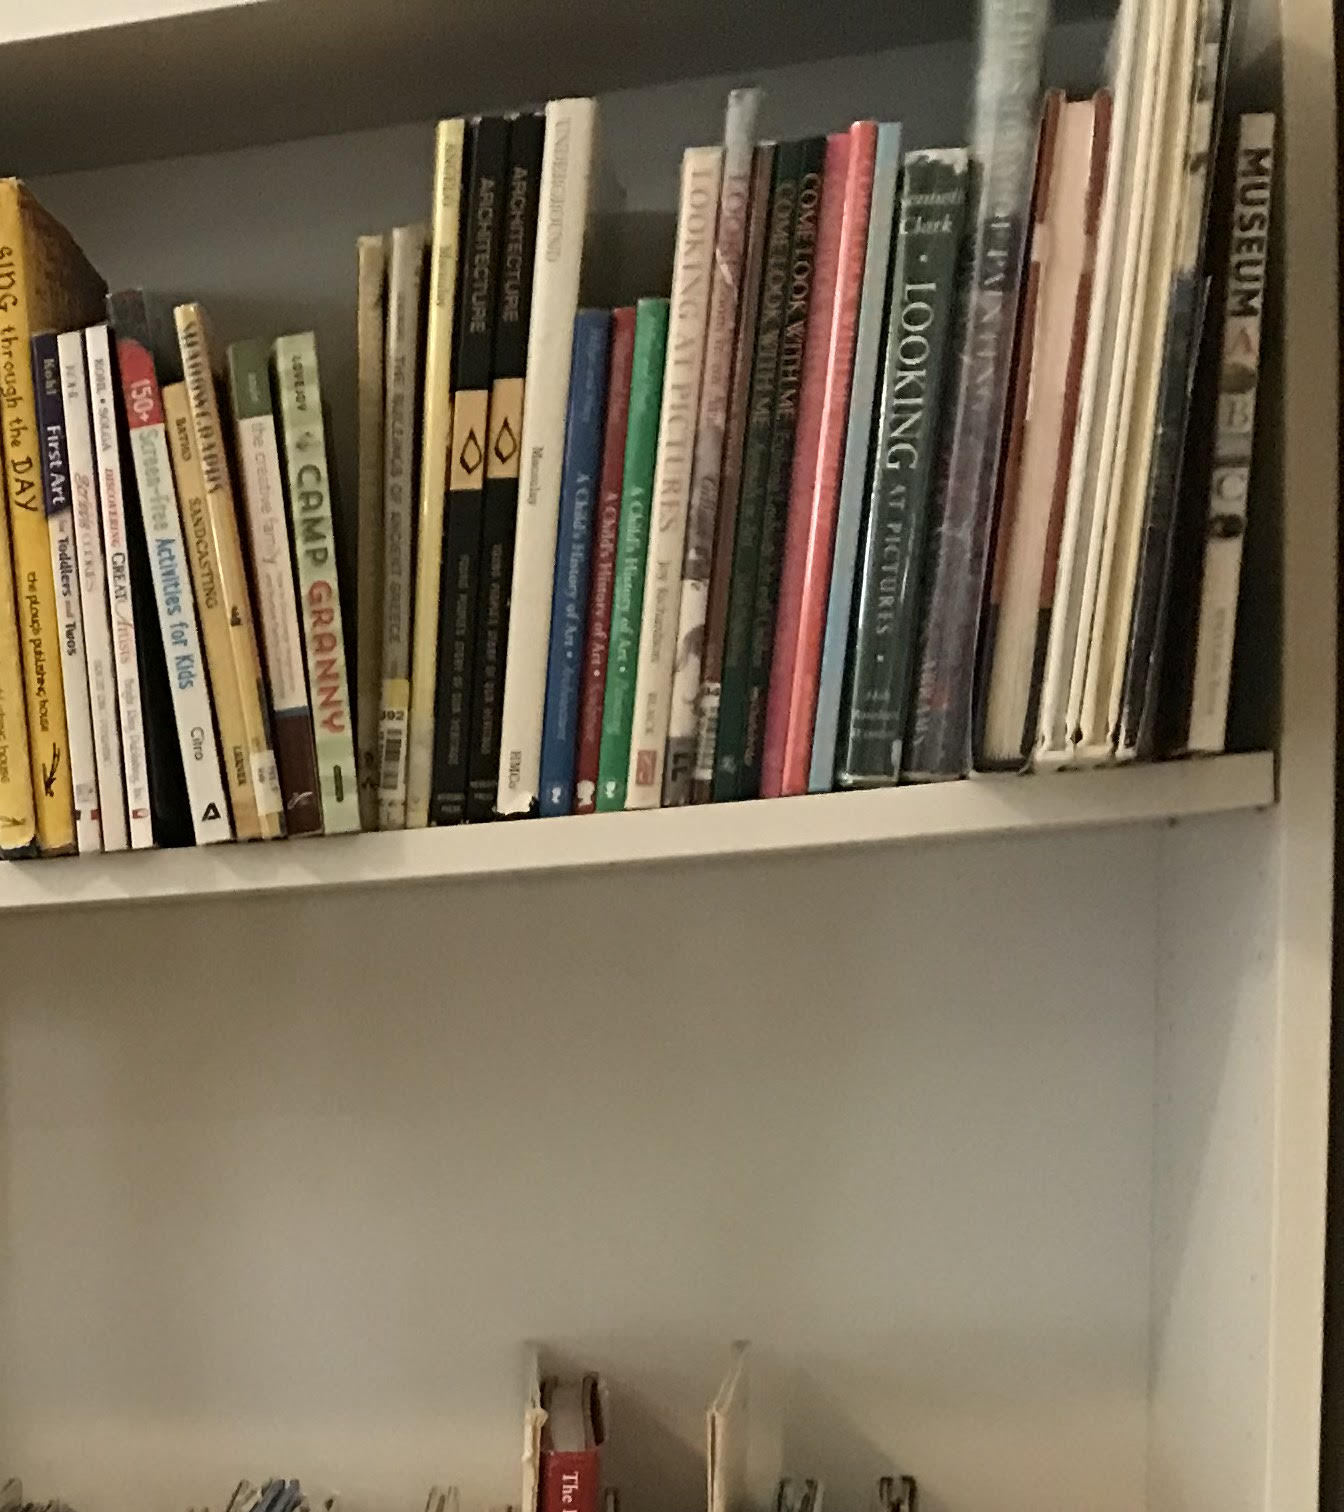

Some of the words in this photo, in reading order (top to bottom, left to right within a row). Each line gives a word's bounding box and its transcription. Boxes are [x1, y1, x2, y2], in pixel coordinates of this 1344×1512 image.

[471, 177, 495, 334] ARCHITECTURE
[503, 166, 528, 324] ARCHITECTURE
[1229, 149, 1270, 317] MUSEUM
[129, 380, 151, 422] 150+
[47, 426, 62, 467] First
[50, 472, 65, 505] Art
[297, 464, 329, 568] CAMP
[59, 537, 71, 597] Toddlers
[156, 536, 181, 617] Activities
[65, 622, 76, 656] Twos
[171, 619, 187, 646] for
[308, 582, 344, 734] GRANNY
[176, 651, 195, 690] Kids
[563, 1473, 579, 1504] The
